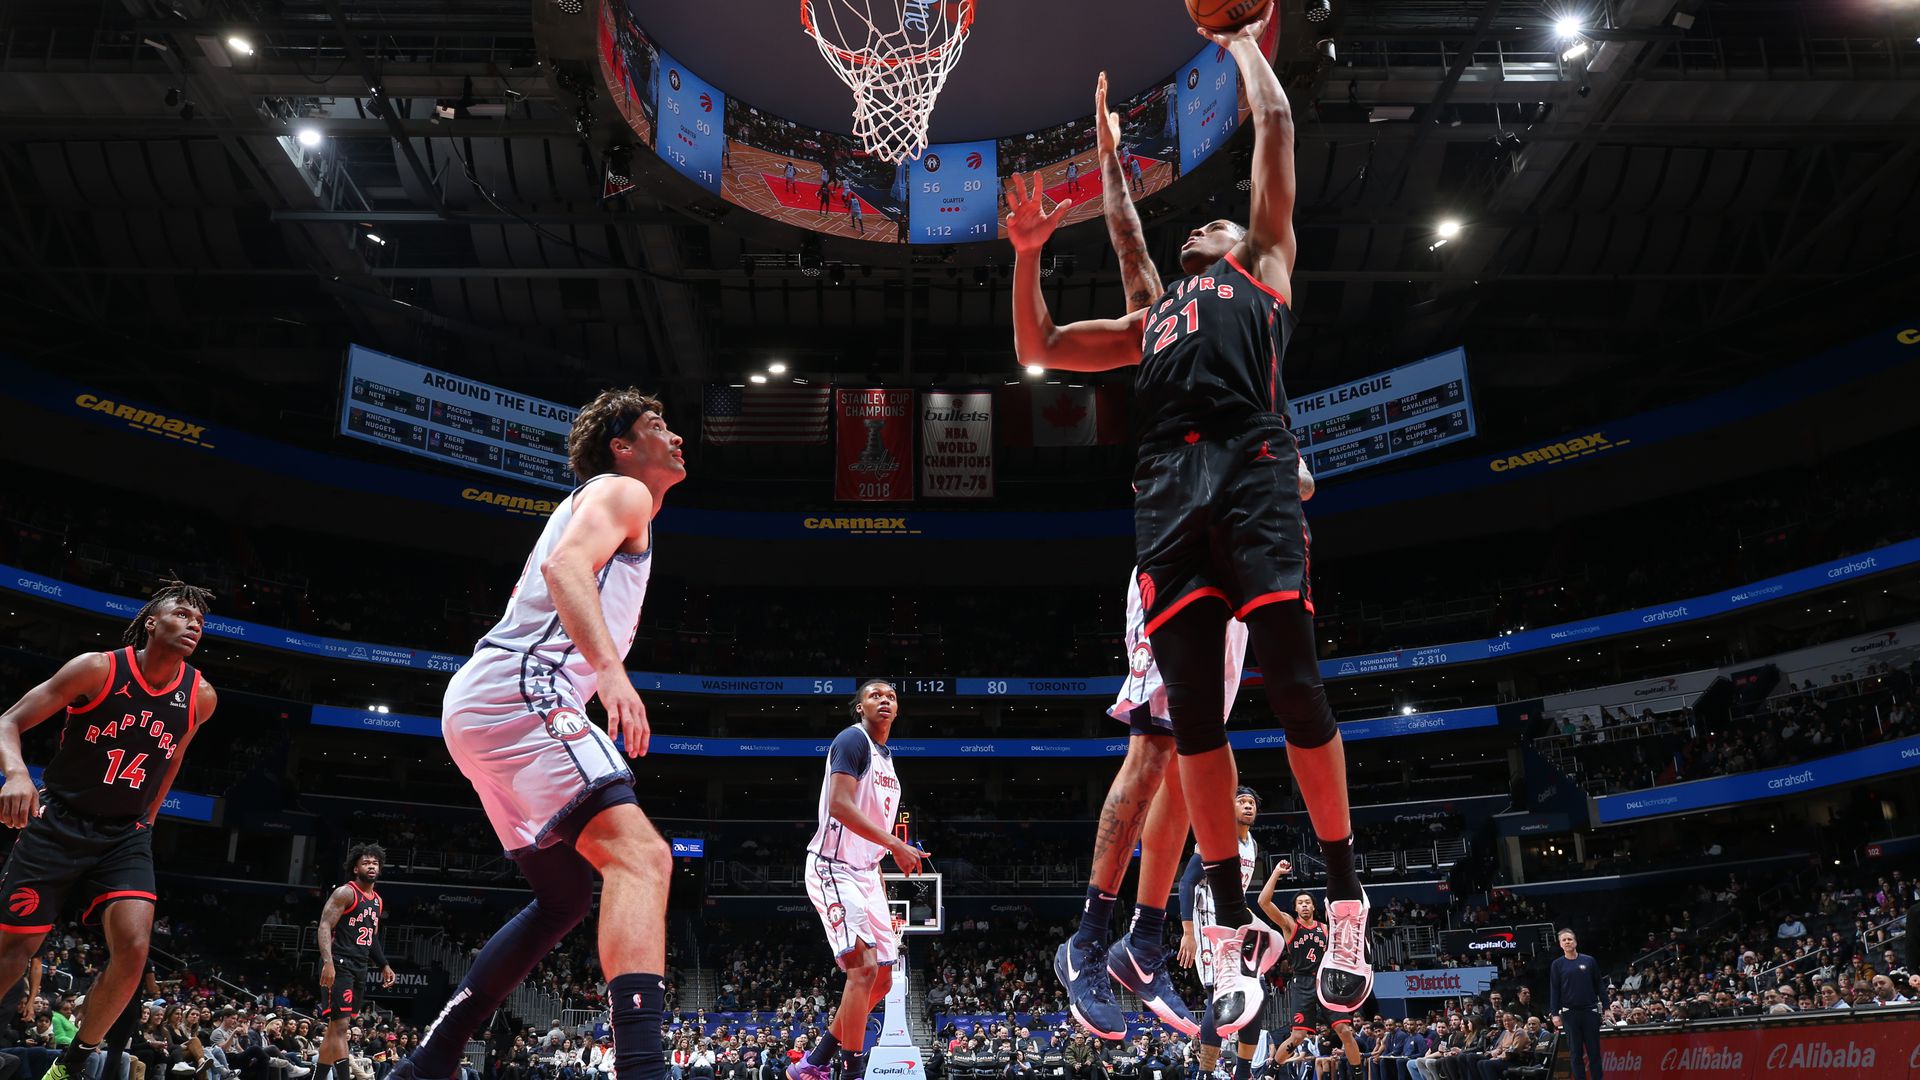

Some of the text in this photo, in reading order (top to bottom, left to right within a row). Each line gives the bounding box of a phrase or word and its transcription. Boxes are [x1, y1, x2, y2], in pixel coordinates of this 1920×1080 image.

[1215, 72, 1227, 91] 80
[667, 96, 680, 115] 56
[1188, 96, 1202, 115] 56
[696, 119, 710, 136] 80
[1192, 137, 1212, 159] 1:12
[667, 145, 686, 167] 1:12
[923, 180, 982, 193] 56 80
[925, 226, 952, 236] 1:12
[1142, 275, 1233, 352] APTORS
[1154, 297, 1199, 354] 21
[368, 391, 386, 401] NETS
[369, 383, 400, 397] HORNETS
[1294, 375, 1392, 415] THE LEAGUE
[422, 372, 579, 425] AROUND THE LEAGU
[841, 392, 910, 405] STANLEY CUP
[1401, 394, 1418, 404] HEAT
[1402, 396, 1438, 412] CAVALIERS
[447, 405, 472, 417] PACERS
[845, 405, 905, 417] CHAMPIONS
[924, 409, 989, 422] bullets
[366, 412, 391, 425] KNICKS
[446, 413, 473, 425] PISTONS
[1325, 414, 1351, 426] CELTICS
[365, 420, 396, 434] NUGGETS
[521, 425, 545, 436] CELTICS
[945, 427, 969, 440] NBA
[1326, 423, 1346, 434] BULLS
[1335, 426, 1362, 438] HALFTIME
[1404, 422, 1427, 434] SPURS
[1405, 427, 1438, 441] CLIPPERS
[373, 430, 402, 443] HALFTIME
[444, 434, 465, 445] 76ERS
[520, 433, 540, 443] BULLS
[443, 442, 463, 452] KINGS
[936, 441, 978, 454] WORLD
[1328, 441, 1360, 455] PELICANS
[451, 452, 479, 463] HALFTIME
[519, 453, 549, 466] PELICANS
[924, 455, 991, 468] CHAMPIONS
[1329, 447, 1367, 463] MAVERICKS
[518, 461, 554, 475] MAVERICKS
[928, 473, 987, 490] 1977-78
[858, 482, 890, 498] 2018
[1827, 557, 1878, 578] carahsoft
[17, 576, 62, 597] carahsoft
[1642, 606, 1688, 623] carahsoft
[203, 621, 245, 636] carahsoft
[1416, 648, 1440, 656] JACKPOT
[1488, 640, 1511, 653] hsoft
[372, 648, 412, 660] FOUNDATION
[391, 656, 411, 666] RAFFLE
[430, 653, 454, 662] JACKPOT
[1359, 656, 1398, 666] FOUNDATION
[1412, 653, 1447, 667] $2,810
[426, 658, 460, 672] $2,810
[1379, 662, 1399, 671] RAFFLE
[656, 681, 661, 689] 3
[701, 679, 833, 693] WASHINGTON 56
[916, 680, 945, 692] 1:12
[987, 680, 1087, 695] 80 TORONTO
[363, 716, 401, 728] carahsoft
[1407, 717, 1445, 730] carahsoft
[85, 710, 177, 760] RAPTORS
[669, 742, 704, 751] carahsoft
[960, 743, 994, 752] carahsoft
[1105, 743, 1129, 752] carahs
[103, 748, 150, 789] 14
[874, 770, 899, 791] Distri
[1767, 771, 1815, 789] carahsoft
[348, 907, 379, 927] RAPTOR
[1306, 948, 1316, 962] 4
[366, 971, 429, 986] NUENTAL
[1405, 972, 1462, 993] District
[1601, 1050, 1642, 1072] libaba
[1677, 1046, 1743, 1070] Alibaba
[1788, 1041, 1876, 1069] Alibaba
